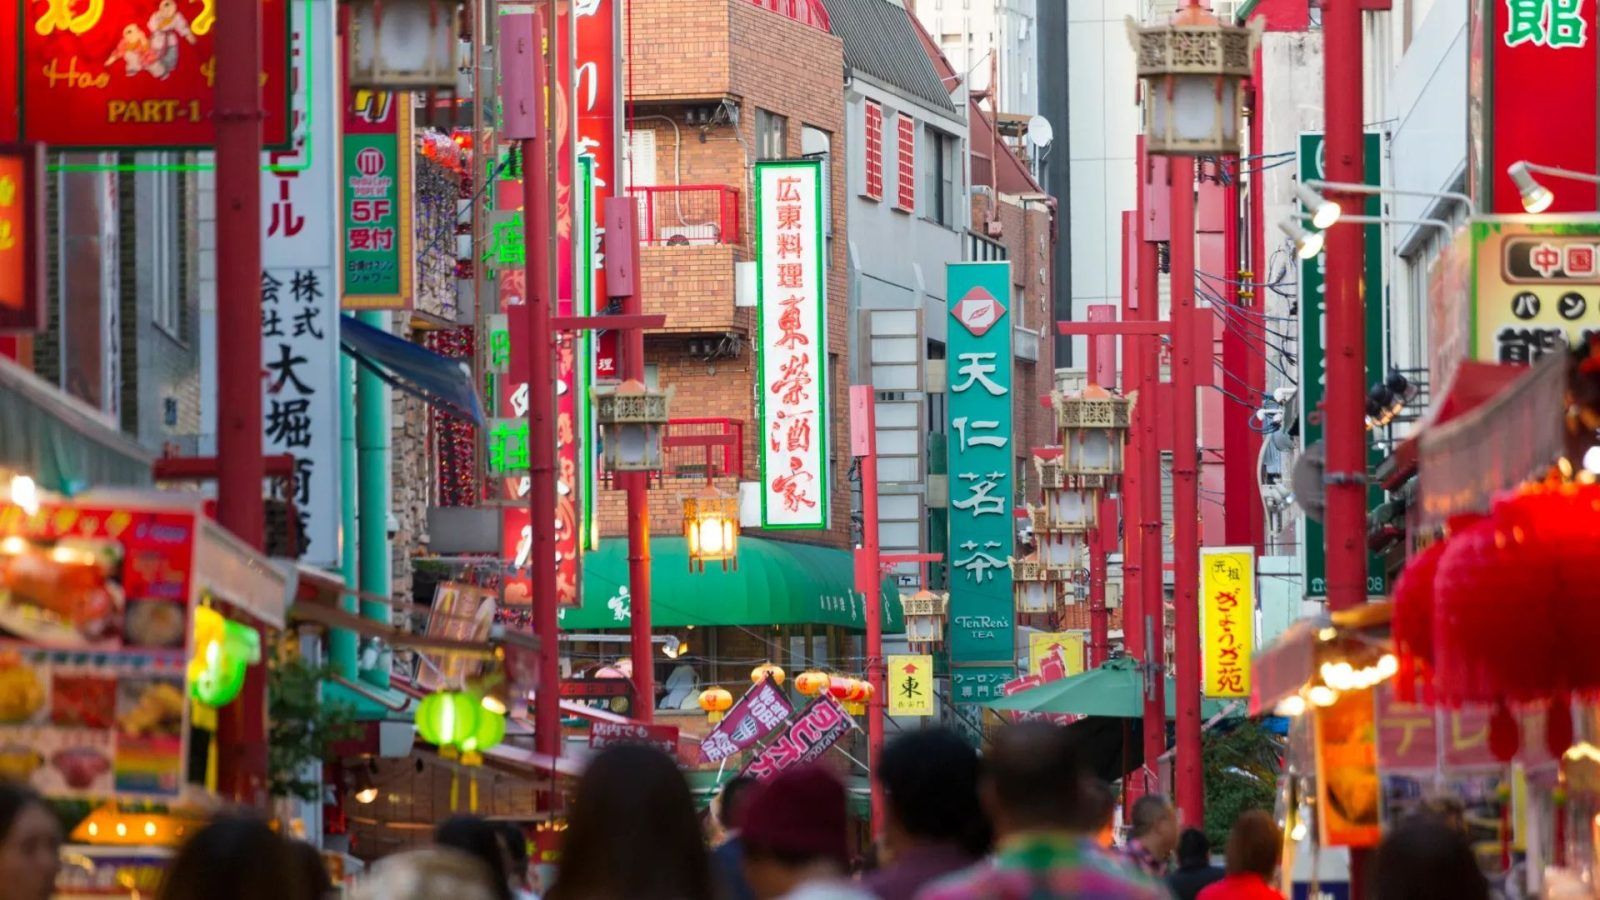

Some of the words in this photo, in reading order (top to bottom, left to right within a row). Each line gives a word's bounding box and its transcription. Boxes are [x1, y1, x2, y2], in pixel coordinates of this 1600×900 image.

[107, 99, 201, 123] PART-1
[351, 199, 391, 222] 5F
[349, 227, 393, 250] 受付
[1531, 245, 1600, 275] 中国
[951, 351, 1009, 584] 天仁茗茶
[971, 631, 995, 639] TEA
[1214, 587, 1245, 693] ぎょうざ苑
[901, 676, 923, 699] 東
